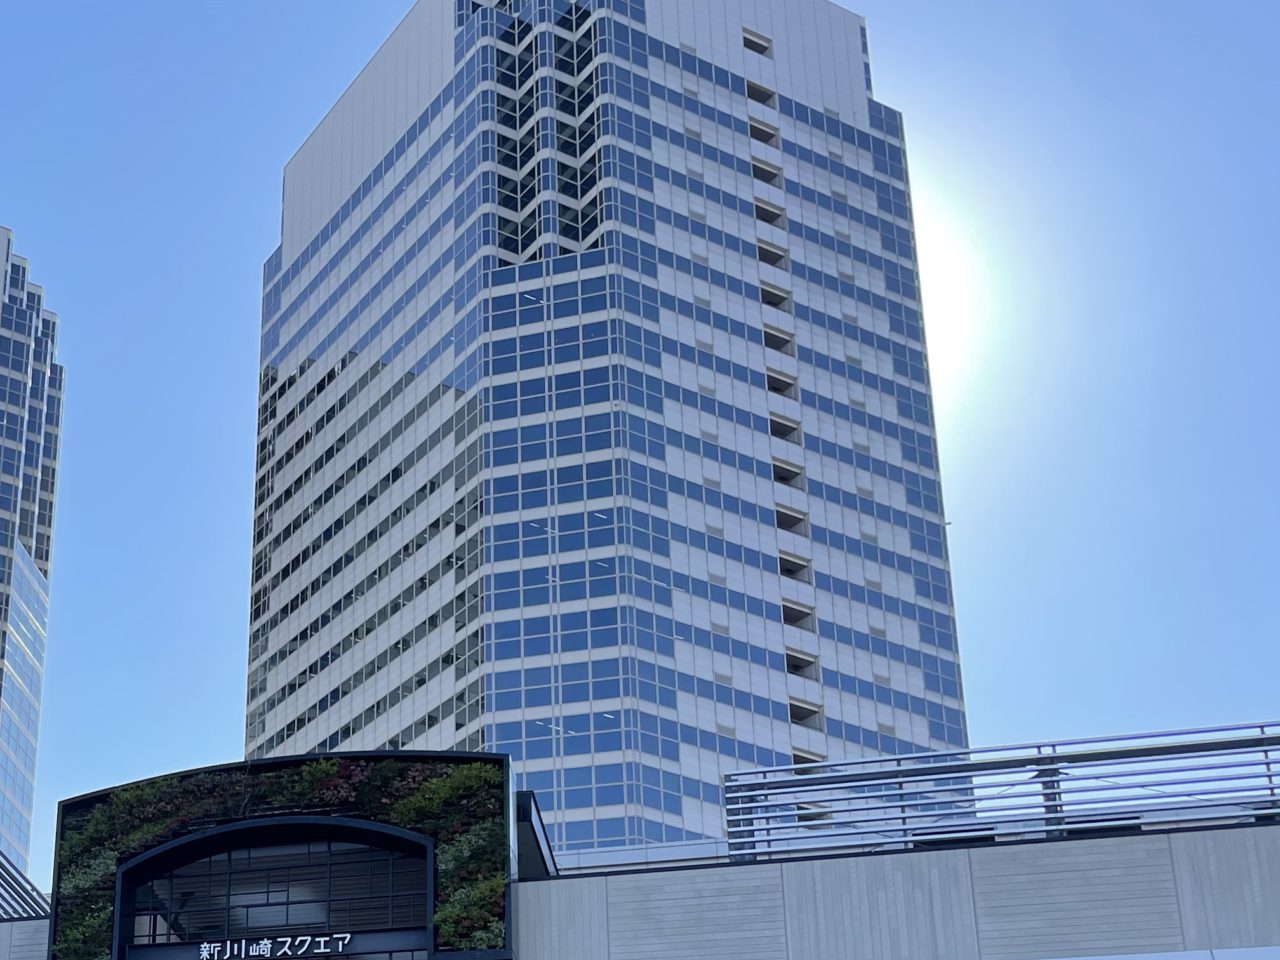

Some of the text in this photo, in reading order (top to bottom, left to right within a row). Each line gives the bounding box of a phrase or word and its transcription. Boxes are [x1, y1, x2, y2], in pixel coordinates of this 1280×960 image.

[199, 933, 351, 960] 新川崎スクエア
